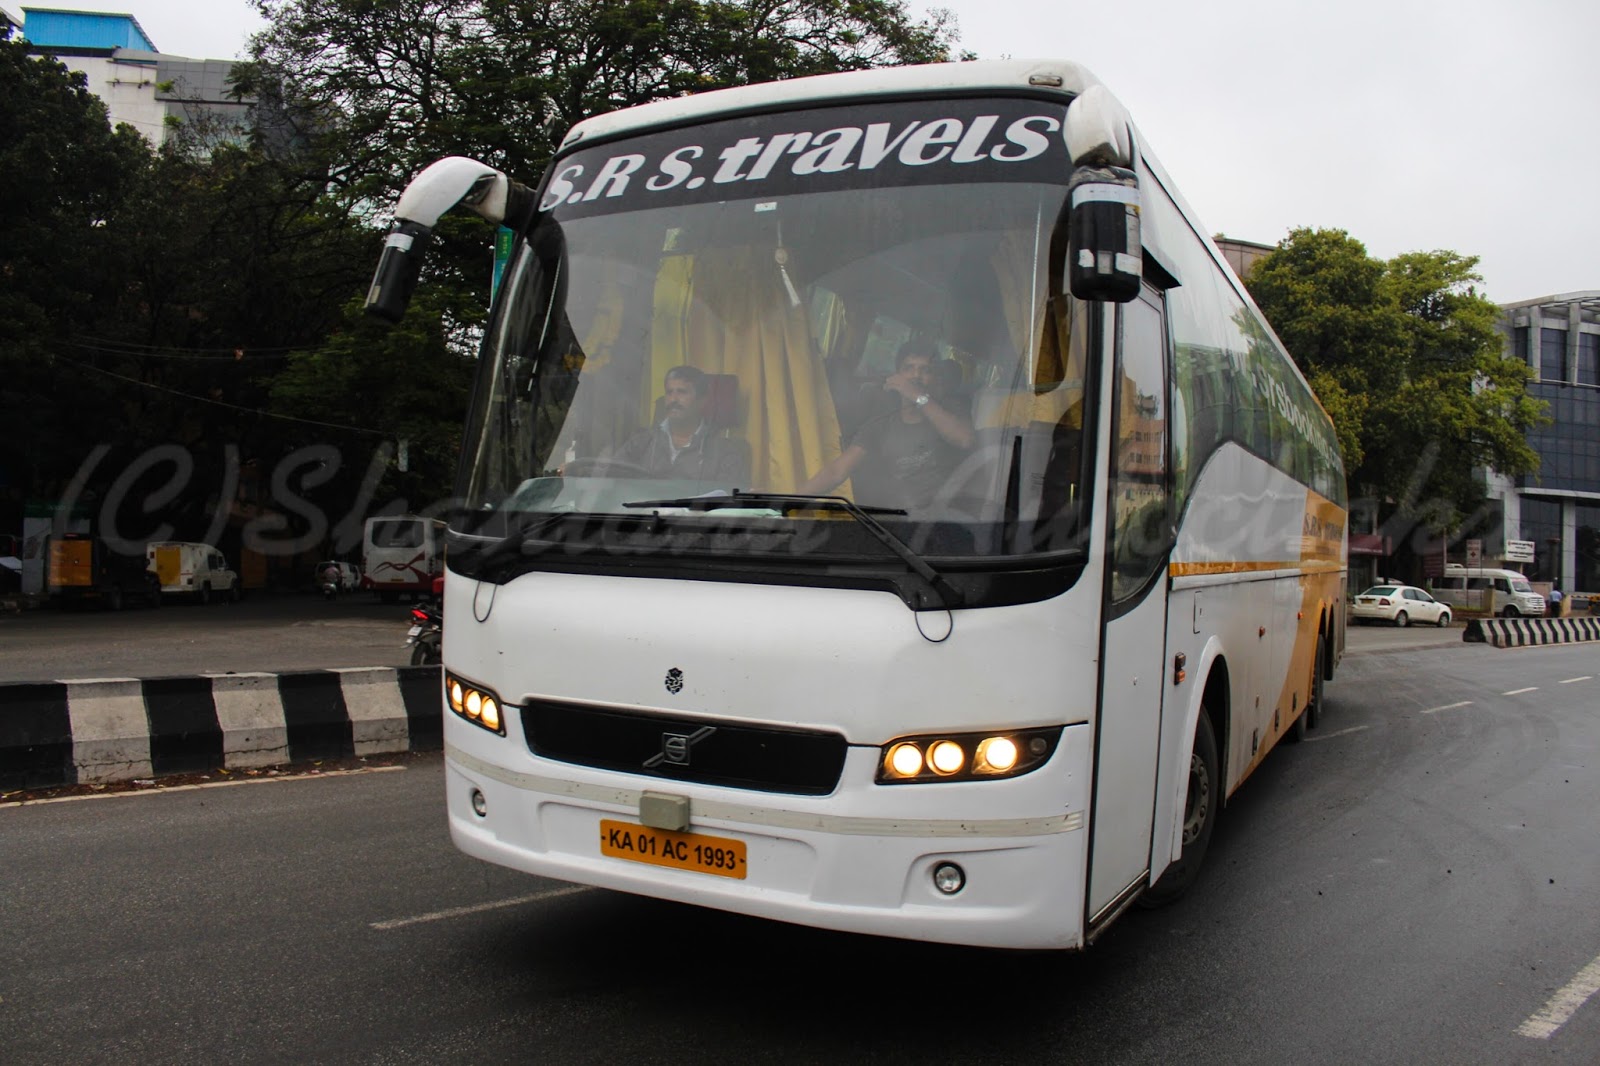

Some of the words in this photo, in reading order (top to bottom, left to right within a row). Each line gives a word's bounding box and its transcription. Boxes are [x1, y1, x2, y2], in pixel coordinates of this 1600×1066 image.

[609, 828, 634, 851] KA
[638, 834, 656, 855] 01
[662, 839, 688, 861] AC
[694, 844, 736, 870] 1993
